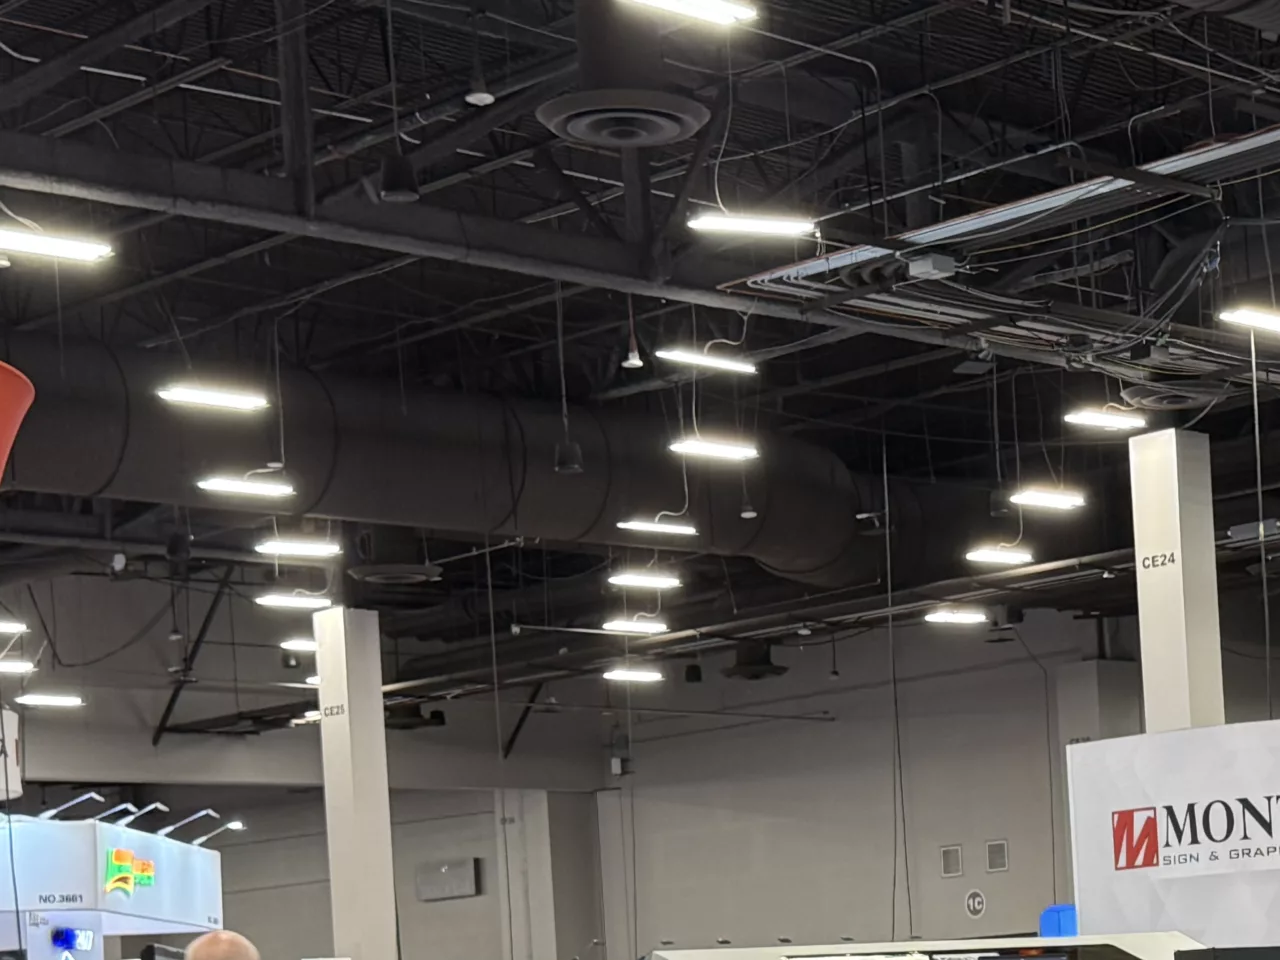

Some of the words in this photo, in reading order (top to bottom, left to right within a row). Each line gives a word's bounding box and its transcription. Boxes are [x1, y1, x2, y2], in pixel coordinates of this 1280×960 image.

[1142, 551, 1176, 569] CE24
[1163, 852, 1200, 866] SIGN
[1209, 851, 1220, 862] &
